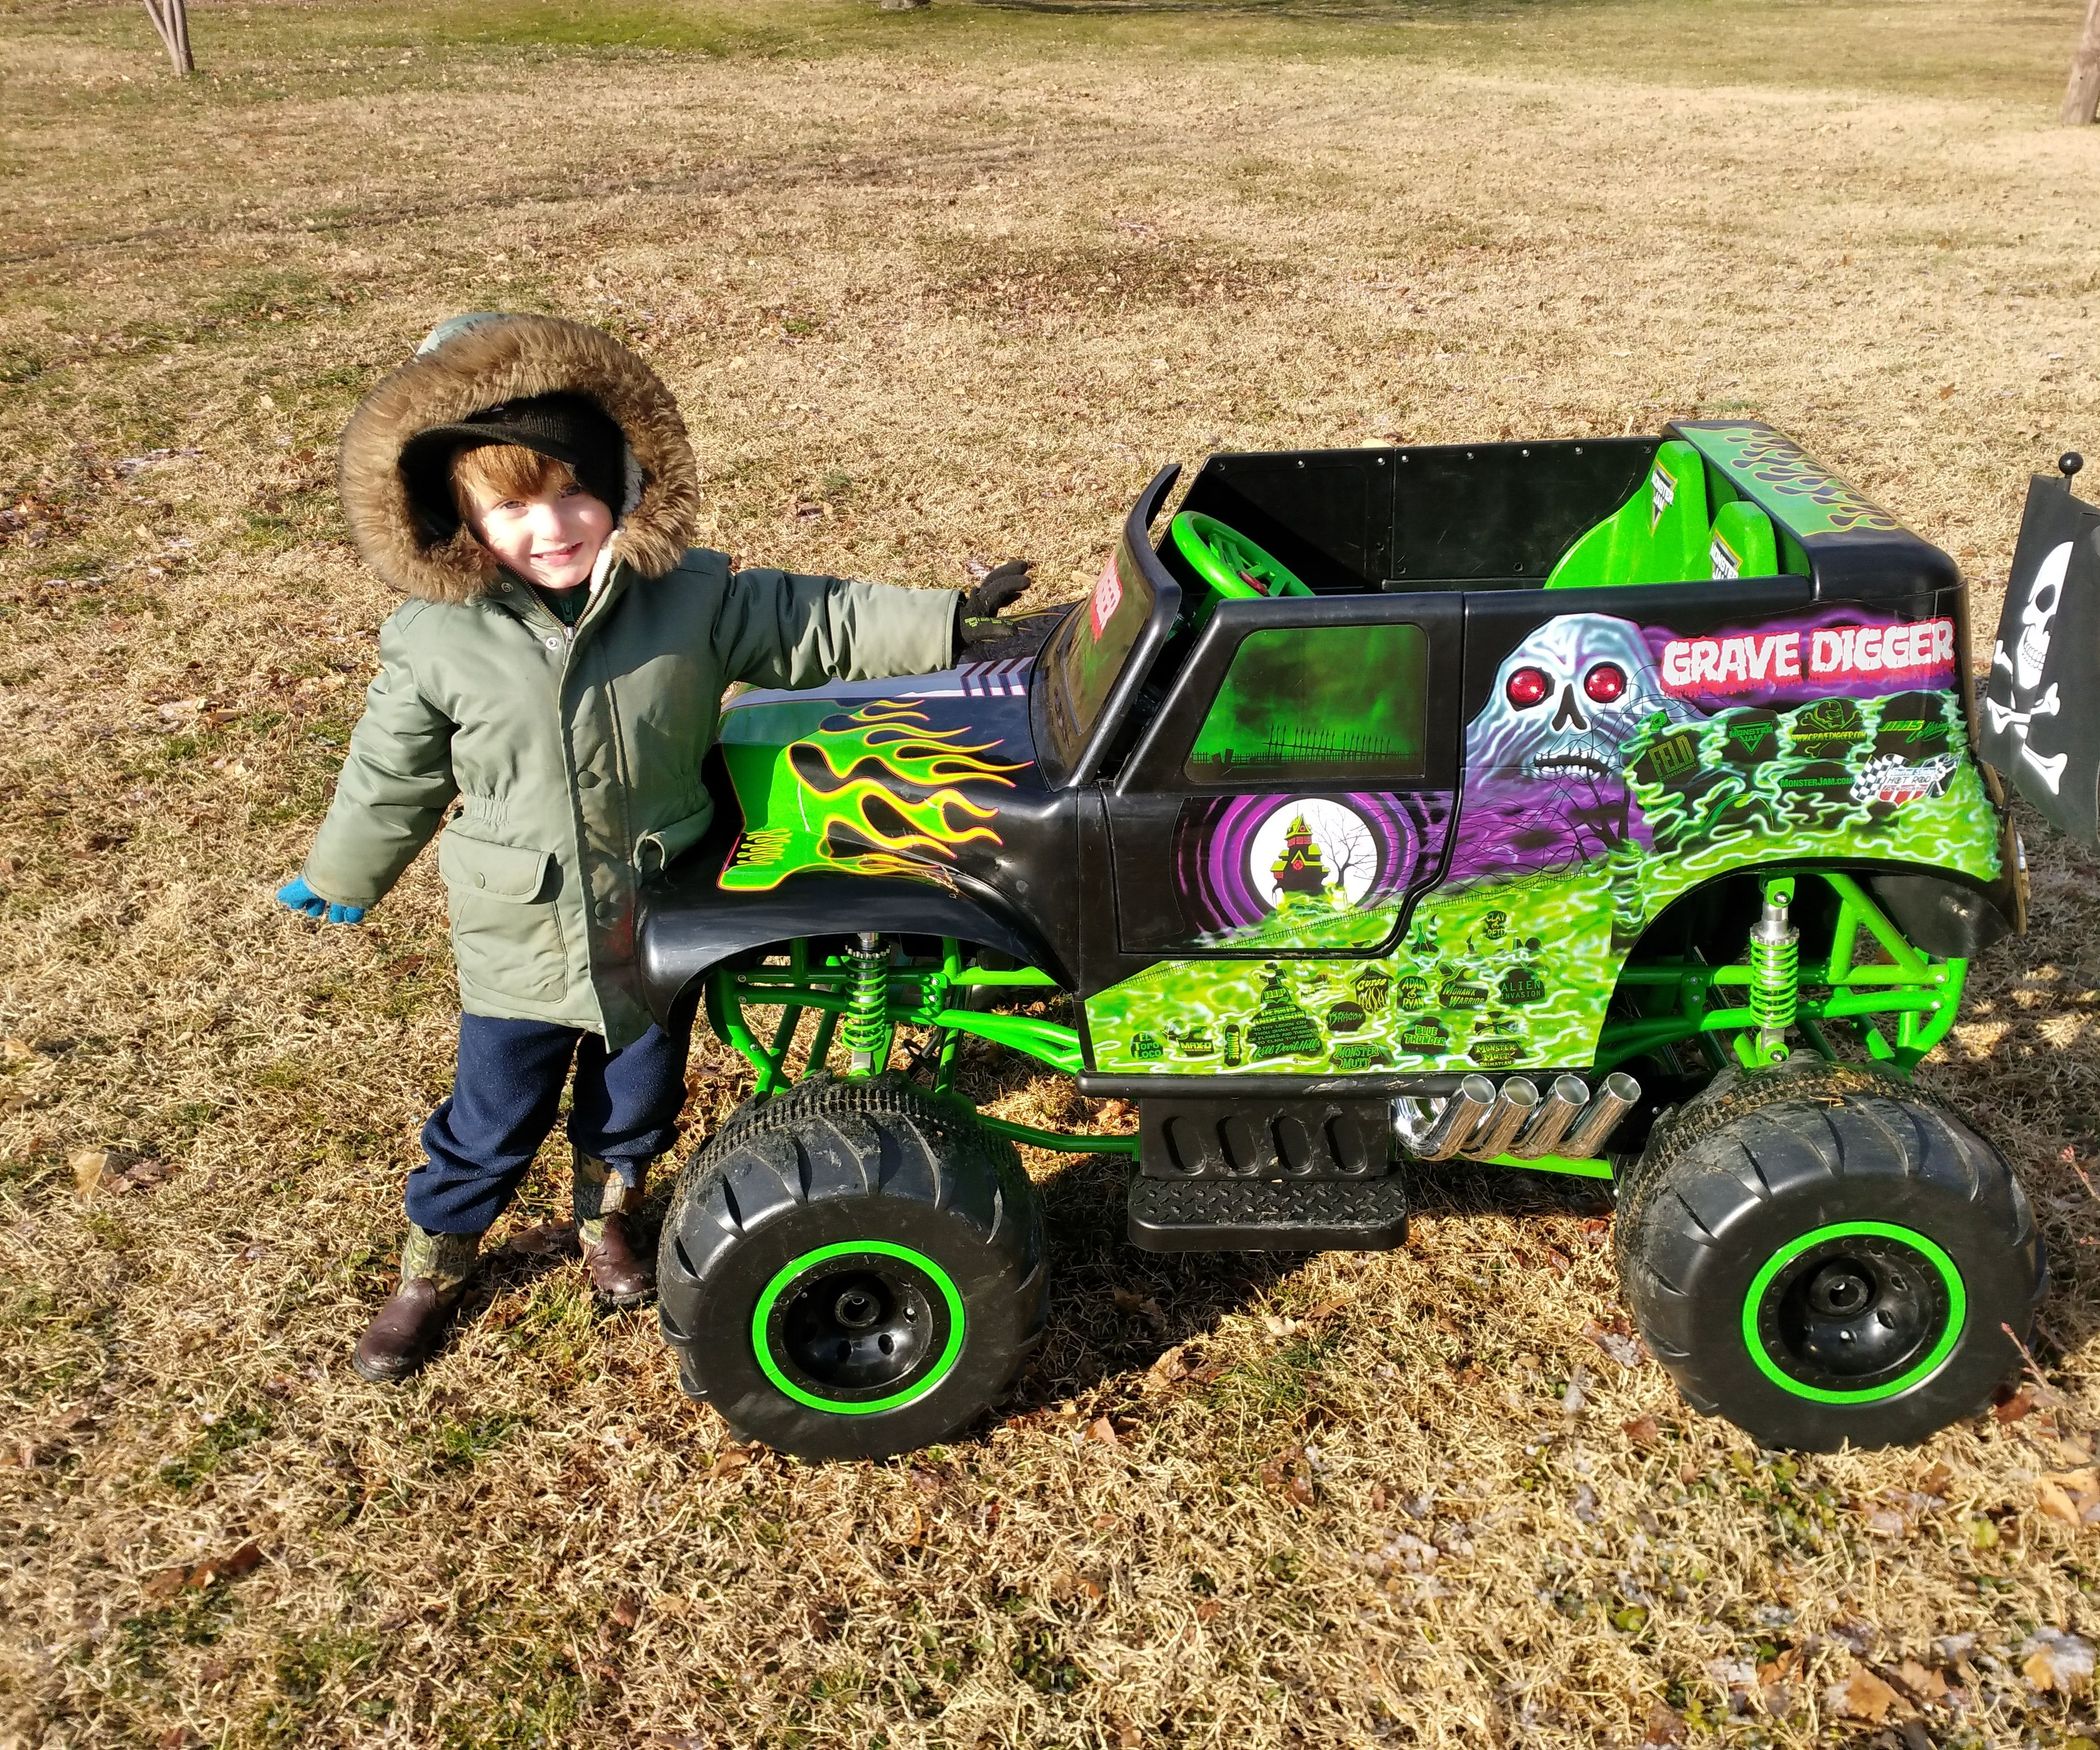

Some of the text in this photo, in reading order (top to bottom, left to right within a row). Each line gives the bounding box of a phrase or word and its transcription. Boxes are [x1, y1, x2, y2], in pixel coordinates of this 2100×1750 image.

[1663, 620, 1954, 687] GRAVE DIGGER
[1729, 726, 1773, 739] MONSTER
[1648, 734, 1696, 780] FELD
[1402, 978, 1427, 991] ADAM
[1501, 980, 1542, 992] ALIEN
[1501, 990, 1542, 1000] INVASION
[1402, 997, 1425, 1010] RYAN
[1253, 1010, 1306, 1024] ANDERSON
[1414, 1024, 1439, 1037] BLUE
[1140, 1033, 1152, 1042] EL
[1403, 1034, 1447, 1046] THUNDER
[1180, 1041, 1212, 1050] MAX-D
[1334, 1045, 1378, 1058] MONSTER
[1476, 1043, 1517, 1053] MONSTER
[1340, 1057, 1370, 1069] MUTT
[1483, 1052, 1510, 1062] MUTT
